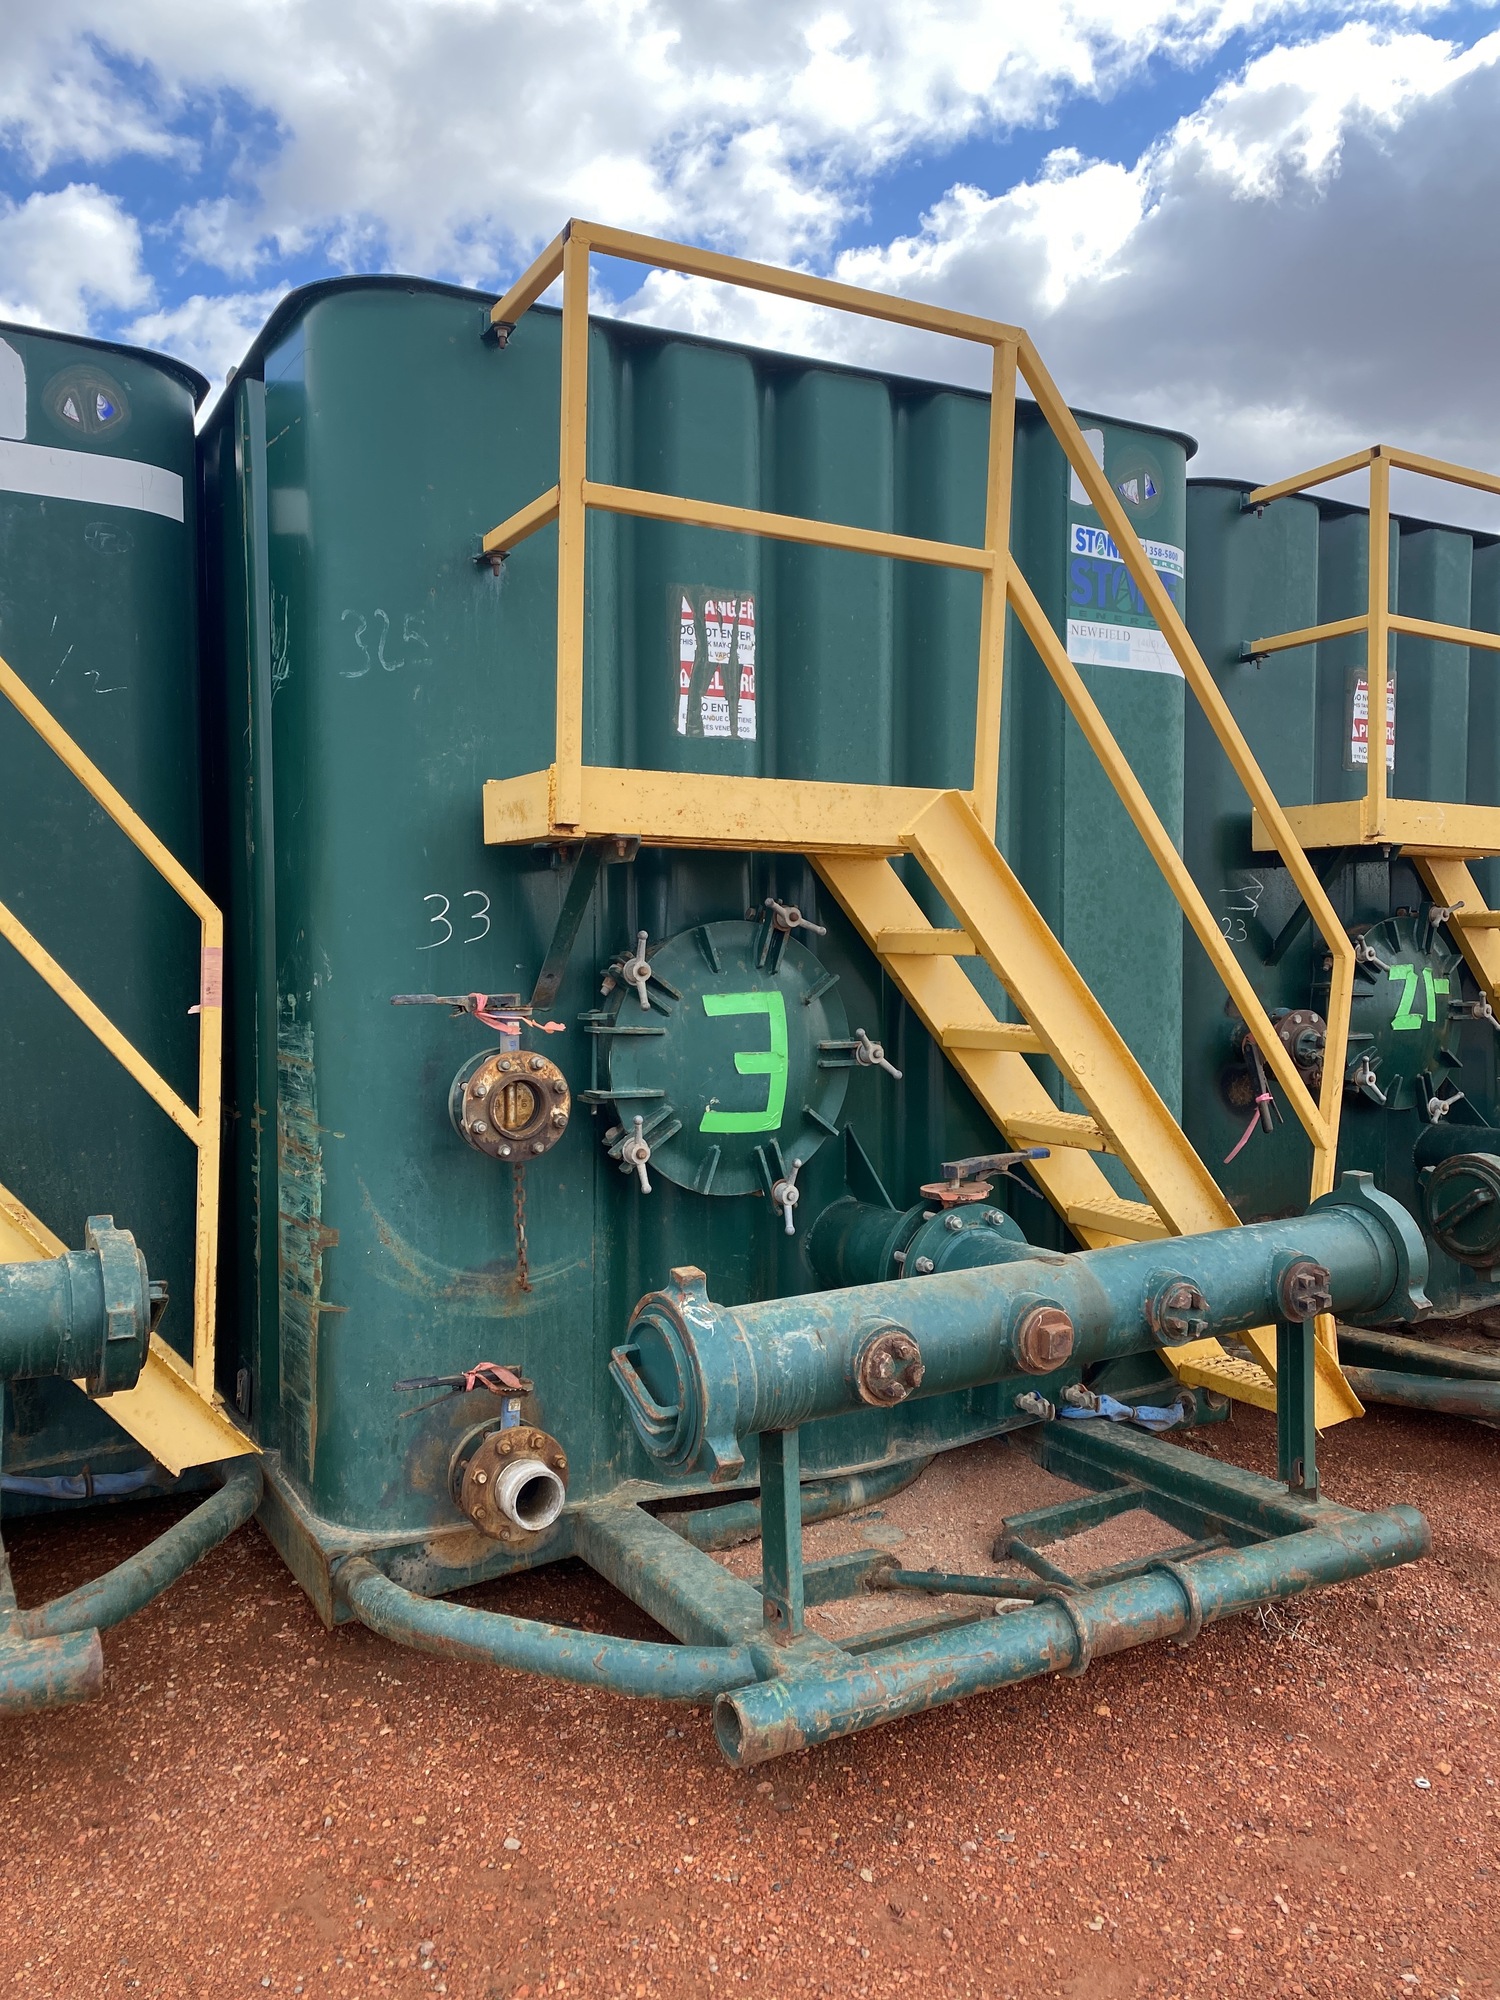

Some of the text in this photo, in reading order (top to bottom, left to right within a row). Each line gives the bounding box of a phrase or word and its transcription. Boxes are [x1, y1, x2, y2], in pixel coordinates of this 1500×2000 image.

[1075, 527, 1124, 560] STON
[705, 598, 754, 620] ANGER
[1078, 608, 1157, 625] ENERG
[705, 627, 718, 638] OT
[721, 629, 751, 641] ENER
[1070, 624, 1131, 642] NEWFIELD
[711, 703, 743, 714] ENTE
[416, 890, 490, 950] 33
[1221, 917, 1248, 942] 23
[699, 990, 789, 1134] 3
